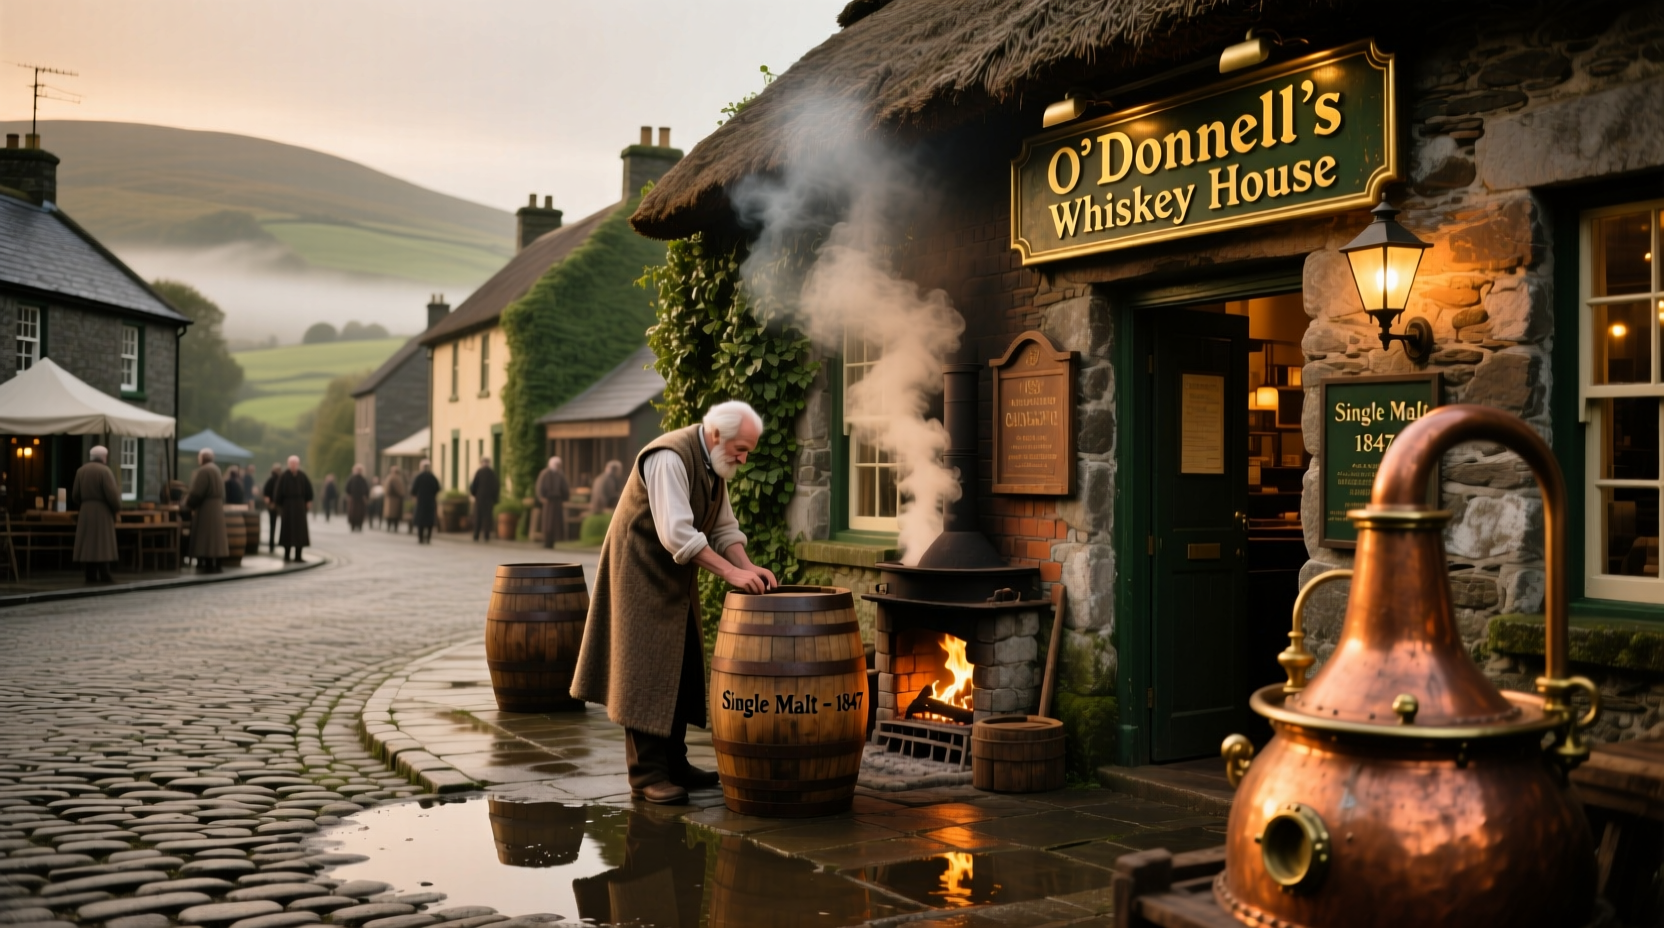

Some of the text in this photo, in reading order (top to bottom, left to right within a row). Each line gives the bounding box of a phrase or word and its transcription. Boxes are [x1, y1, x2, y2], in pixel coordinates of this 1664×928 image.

[1047, 80, 1342, 195] O’Donnell’s
[1048, 156, 1337, 239] Whiskey House
[1335, 401, 1429, 427] Single Malt
[1355, 433, 1395, 453] 1847
[722, 689, 769, 718] Single
[775, 694, 818, 714] Malt
[836, 692, 864, 712] 1847
